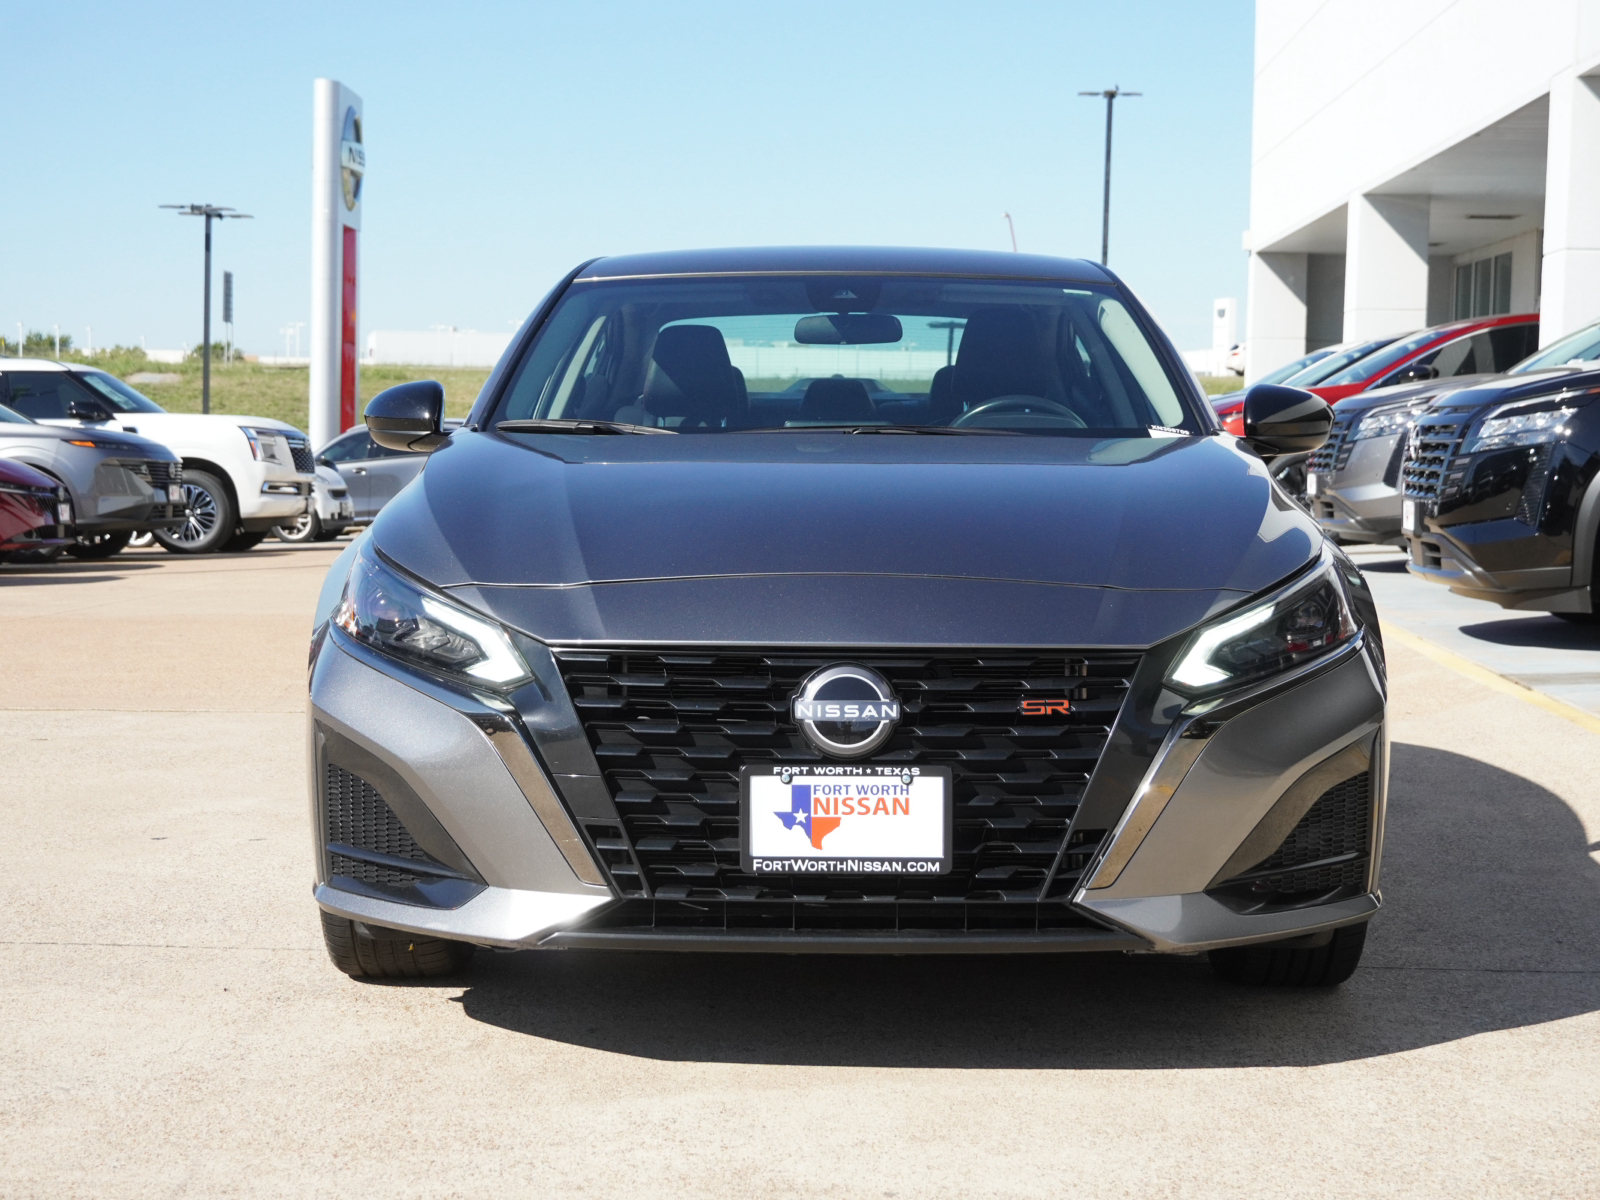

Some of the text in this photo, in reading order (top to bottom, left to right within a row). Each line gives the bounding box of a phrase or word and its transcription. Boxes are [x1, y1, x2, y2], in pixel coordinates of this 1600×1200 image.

[797, 704, 897, 718] NISSAN
[1020, 699, 1071, 714] SR
[773, 766, 920, 776] FORT WORTH TEXAS
[813, 784, 910, 796] FORT WORTH
[813, 797, 910, 816] NISSAN
